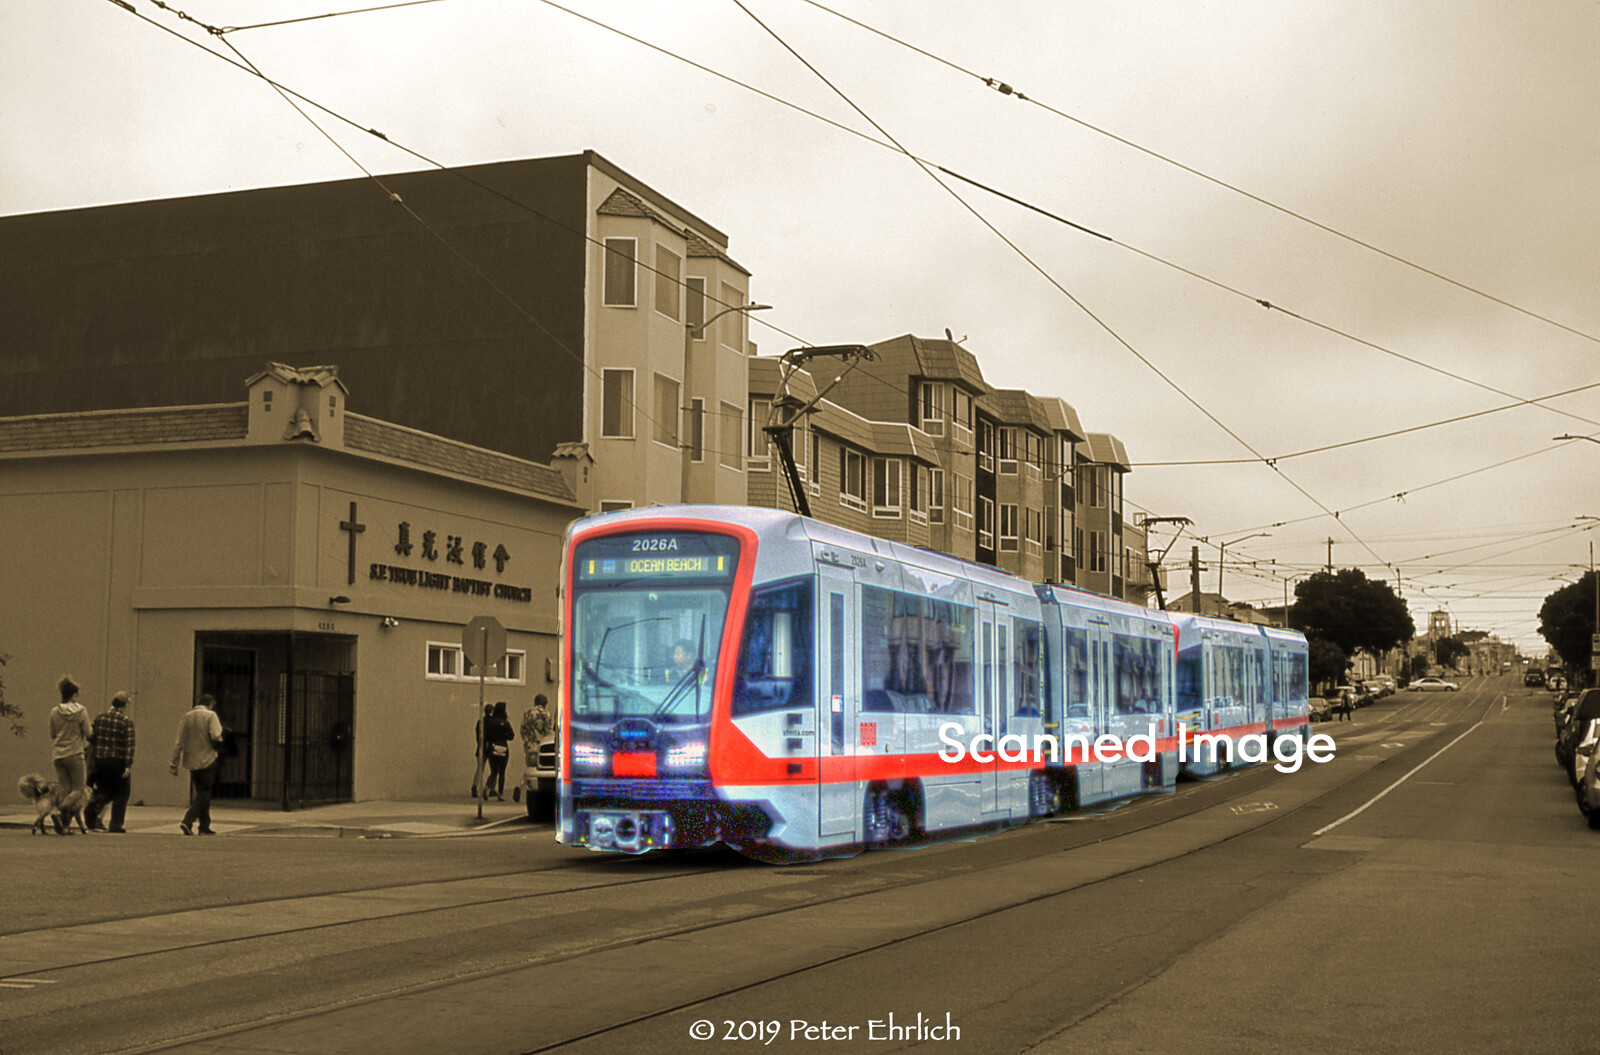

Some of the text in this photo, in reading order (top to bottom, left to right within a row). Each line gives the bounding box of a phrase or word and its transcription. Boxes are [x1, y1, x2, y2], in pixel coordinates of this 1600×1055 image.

[632, 538, 679, 552] 2026A
[630, 559, 665, 573] OCEAN
[666, 557, 702, 572] BEACH
[388, 566, 418, 586] TRUE
[418, 570, 451, 591] LIGHT
[452, 576, 493, 597] BAPTIST
[494, 582, 533, 604] CHURCH
[782, 729, 815, 737] sfmta.com
